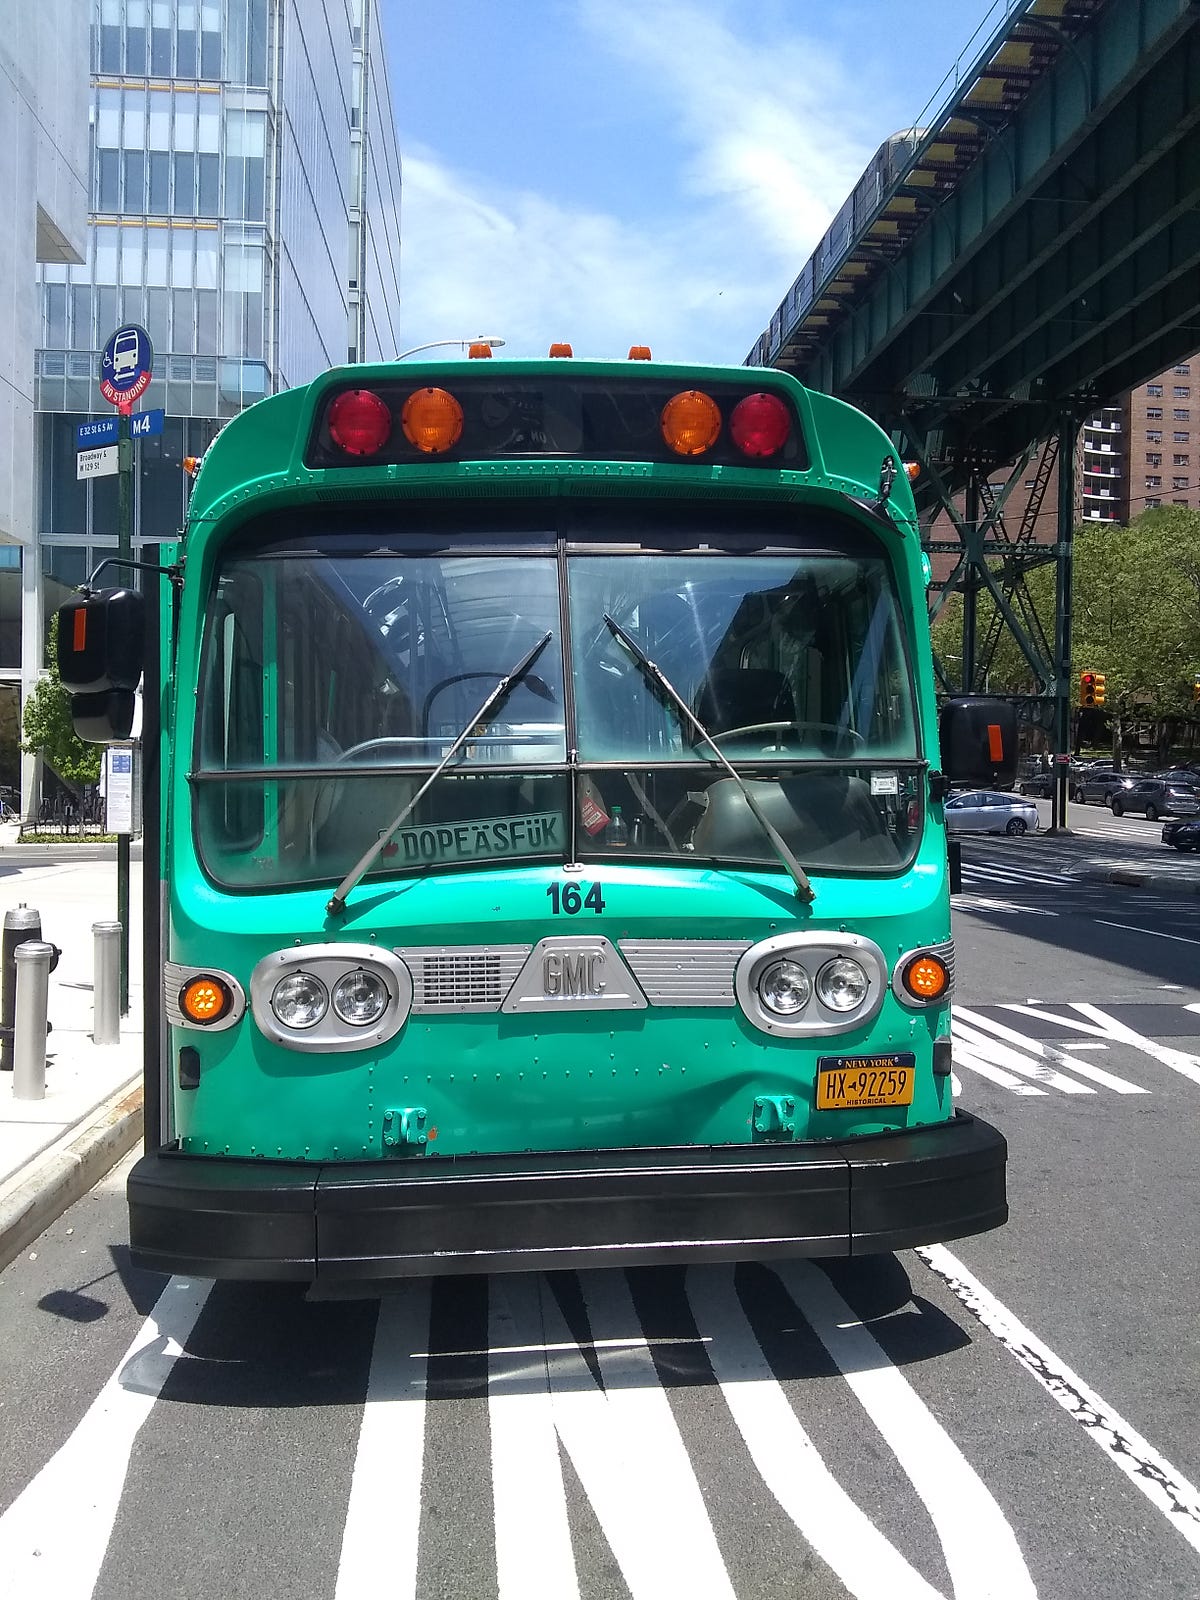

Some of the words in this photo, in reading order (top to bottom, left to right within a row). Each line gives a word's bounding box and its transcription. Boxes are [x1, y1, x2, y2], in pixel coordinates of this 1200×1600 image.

[104, 384, 113, 397] NO
[113, 376, 146, 401] STANDING
[80, 428, 83, 436] E
[84, 427, 90, 435] 32
[91, 426, 96, 434] St
[102, 424, 106, 432] 5
[107, 423, 113, 431] Av
[133, 415, 150, 434] M4
[80, 452, 102, 462] Broadway
[85, 463, 93, 471] 129
[547, 881, 606, 915] 164
[543, 952, 606, 996] GMC
[845, 1059, 867, 1069] NEW
[870, 1058, 894, 1067] YORK
[826, 1073, 846, 1099] HX
[858, 1070, 907, 1097] 92259
[846, 1098, 887, 1106] HISTORICAL
